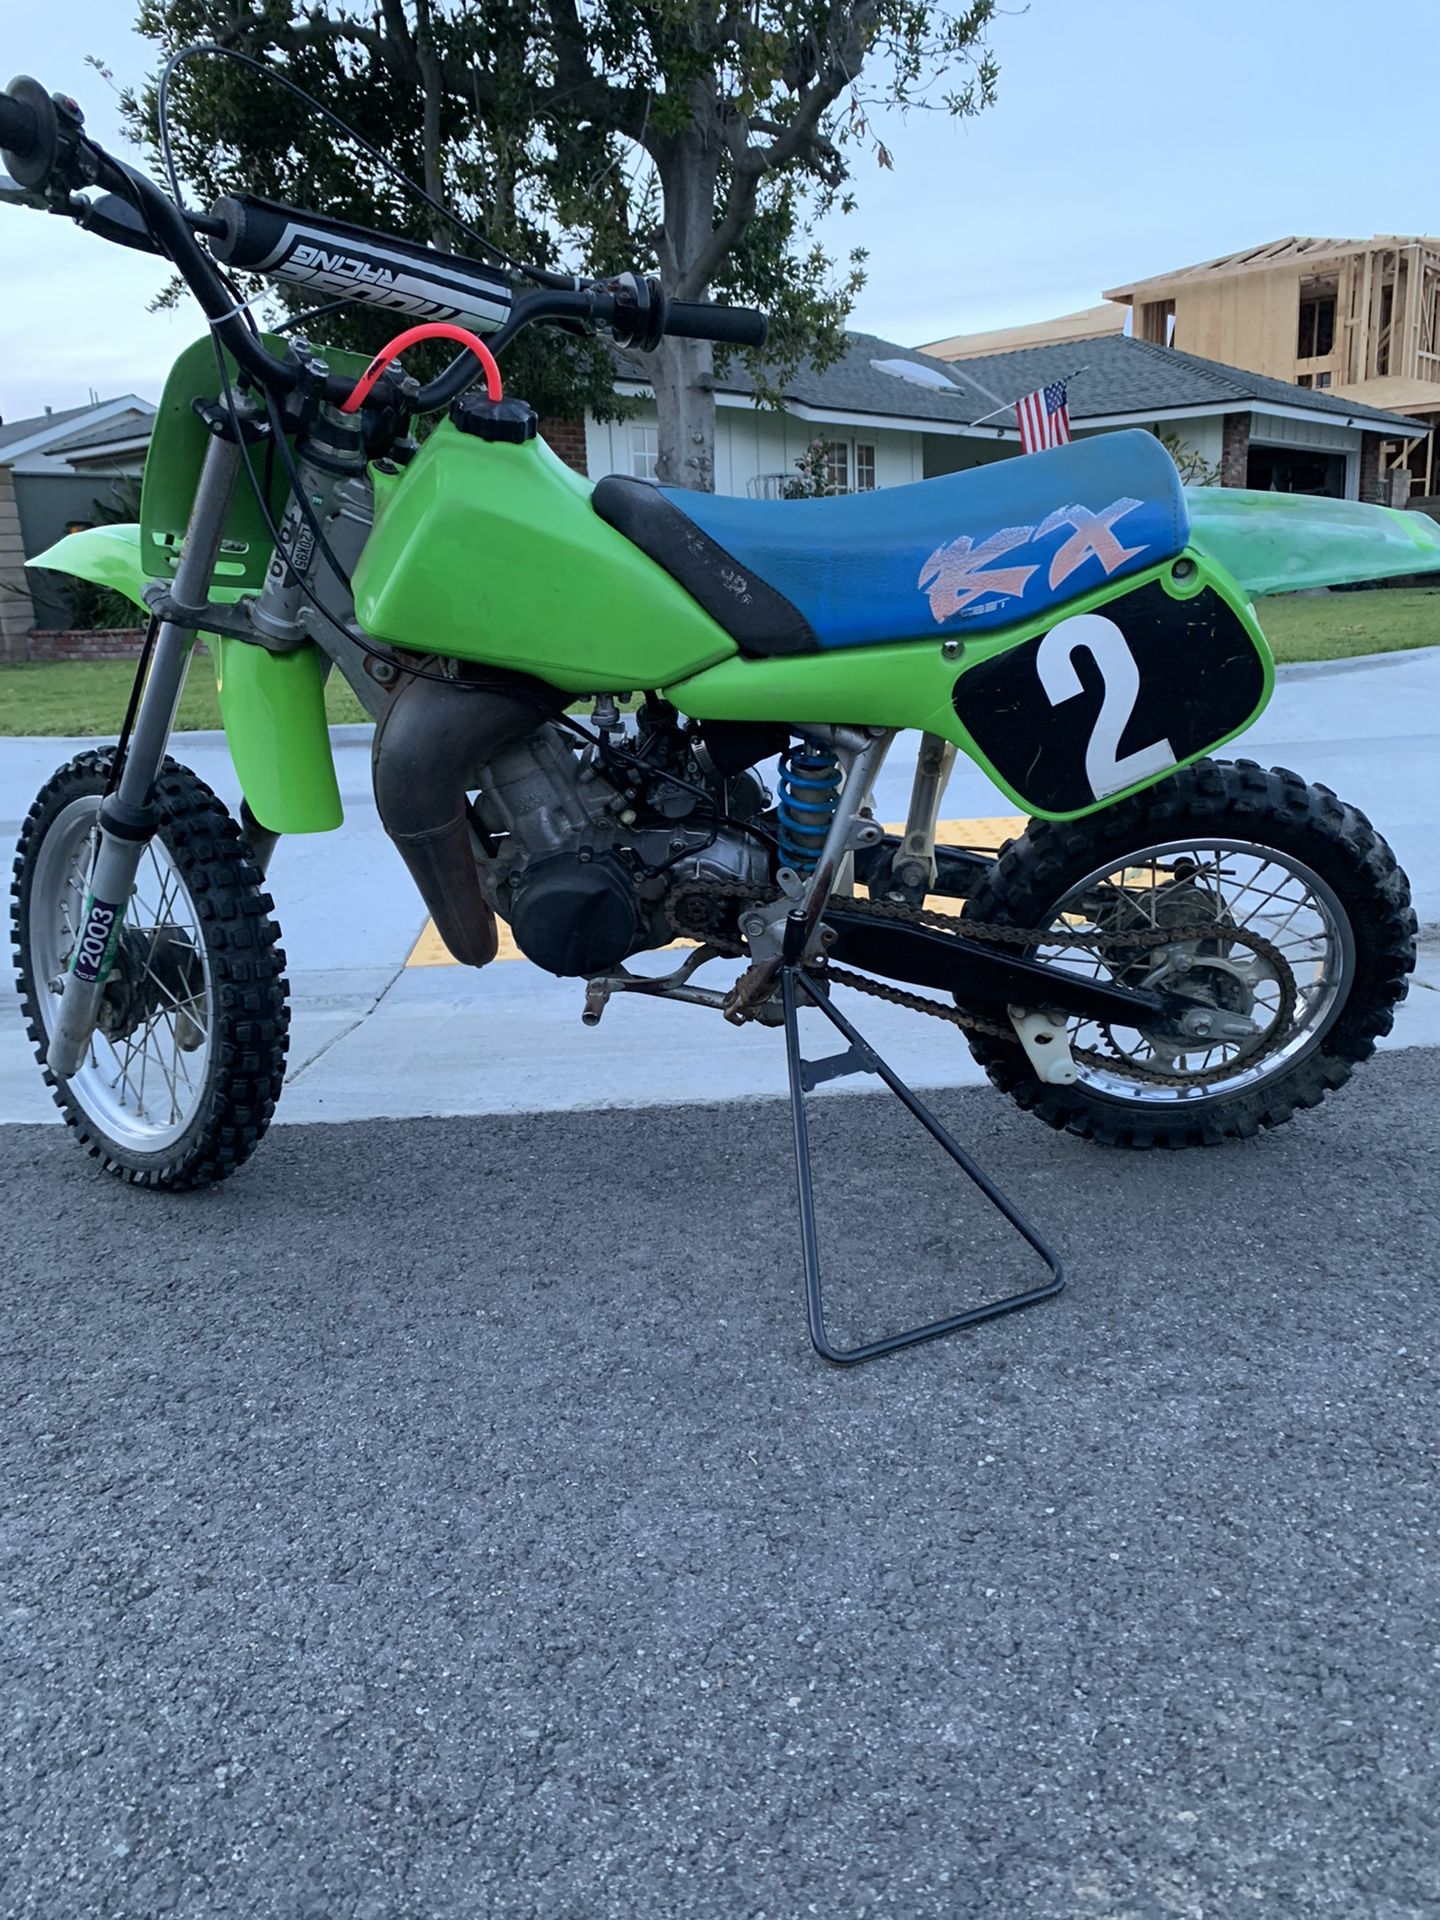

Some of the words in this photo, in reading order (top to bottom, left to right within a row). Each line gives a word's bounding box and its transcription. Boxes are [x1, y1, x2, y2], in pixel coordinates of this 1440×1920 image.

[289, 244, 397, 289] RACING
[918, 497, 1151, 624] KX
[1036, 614, 1177, 801] 2
[79, 907, 114, 968] 2003
